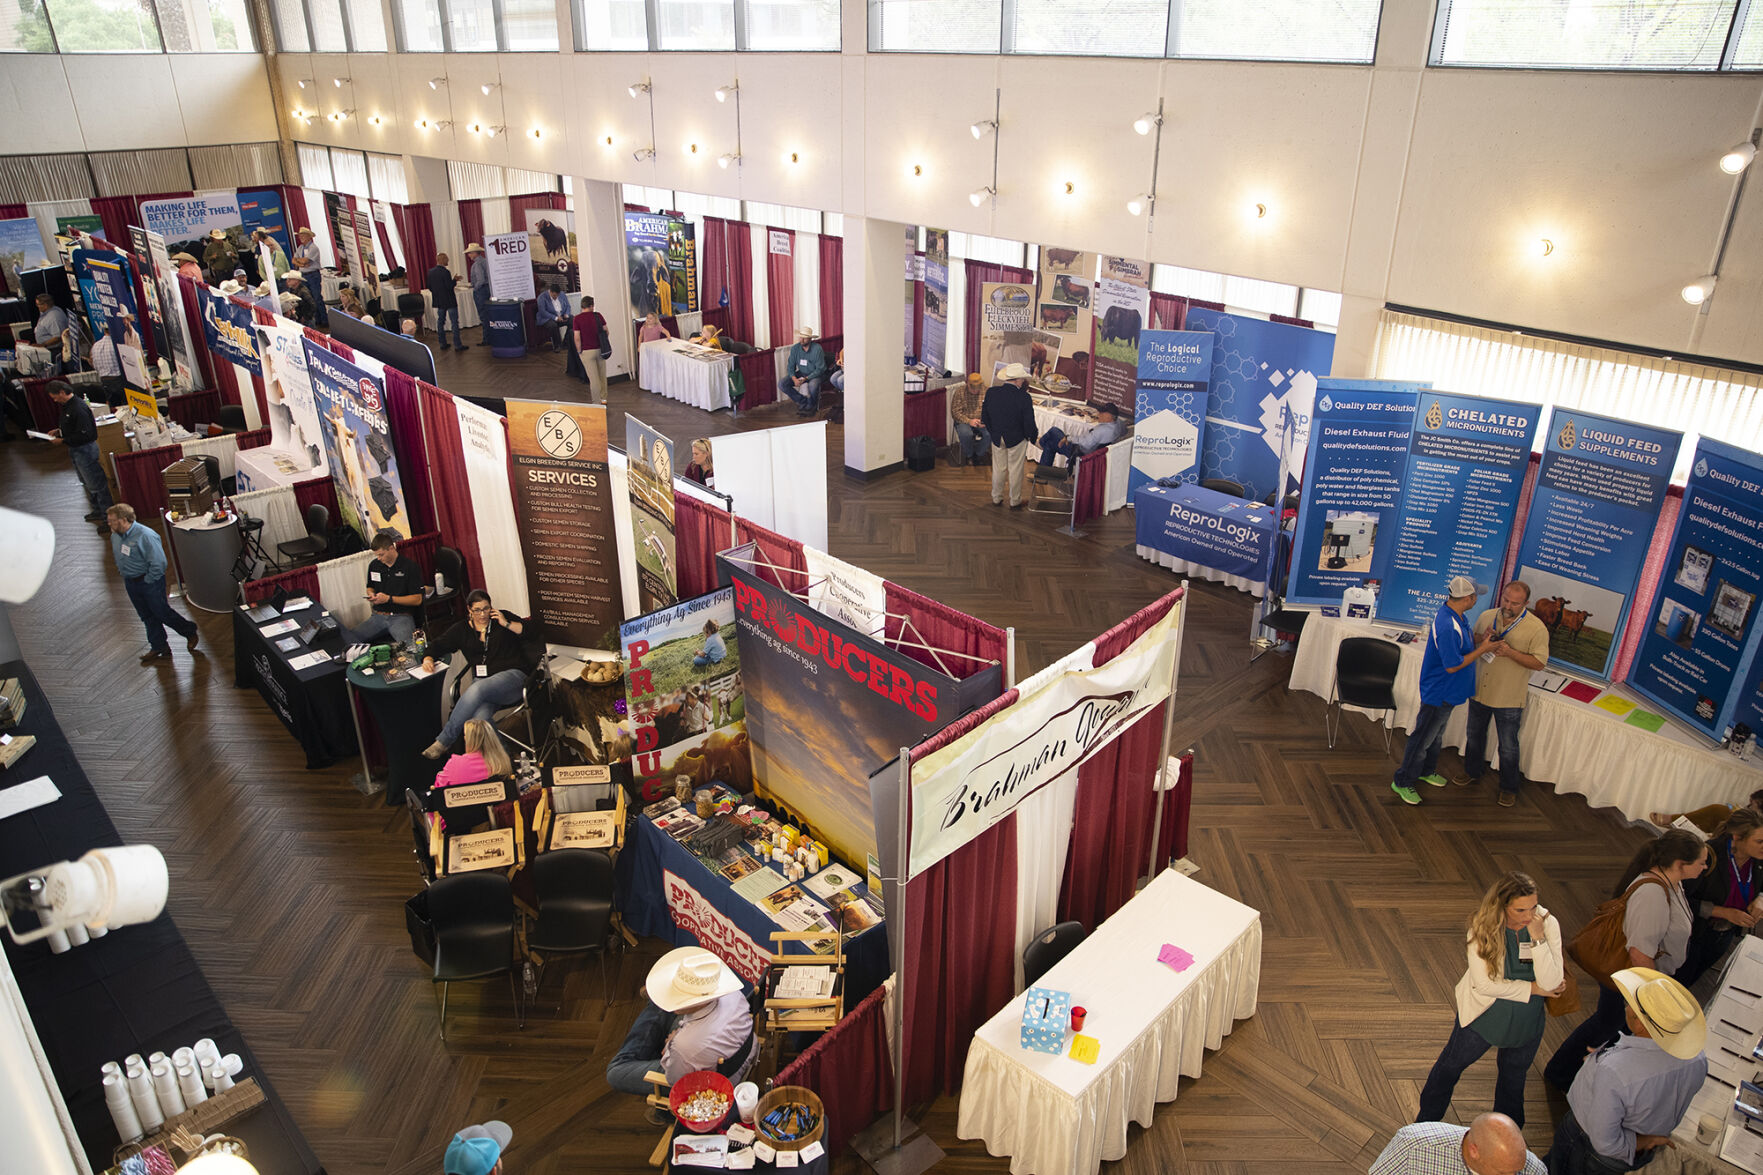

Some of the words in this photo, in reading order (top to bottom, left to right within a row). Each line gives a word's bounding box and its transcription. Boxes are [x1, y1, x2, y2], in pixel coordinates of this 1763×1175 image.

[145, 203, 185, 213] MAKING
[187, 200, 207, 210] LIFE
[148, 210, 185, 221] BETTER
[187, 209, 206, 219] FOR
[208, 206, 238, 216] THEM,
[150, 218, 184, 229] MAKES
[187, 216, 206, 226] LIFE
[501, 240, 527, 255] RED
[1150, 342, 1165, 352] The
[1167, 343, 1200, 355] Logical
[1146, 352, 1202, 364] Reproductive
[1158, 362, 1187, 373] Choice
[1142, 381, 1194, 390] www.reprologix.com
[1335, 402, 1365, 411] Quality
[1366, 403, 1384, 411] DEF
[1448, 408, 1528, 428] CHELATED
[1324, 428, 1350, 436] Diesel
[1352, 429, 1386, 438] Exhaust
[1388, 430, 1410, 439] Fluid
[1446, 421, 1525, 438] MICRONUTRIENTS
[1135, 435, 1191, 447] ReproLogix
[1323, 442, 1407, 453] qualitydefsolutions.com
[1582, 428, 1625, 445] LIQUID
[1627, 438, 1662, 454] FEED
[1579, 441, 1658, 466] SUPPLEMENTS
[537, 459, 567, 467] BREEDING
[567, 460, 591, 469] SERVICE
[1329, 467, 1350, 475] Quality
[1363, 468, 1391, 476] Solutions,
[1558, 456, 1575, 465] Liquid
[1576, 459, 1588, 467] feed
[1600, 465, 1614, 473] been
[1623, 470, 1650, 481] excellent
[528, 470, 597, 487] SERVICES
[1324, 474, 1352, 482] distributor
[1373, 477, 1399, 485] chemical,
[1549, 467, 1564, 475] many
[1564, 470, 1580, 479] years.
[1582, 473, 1597, 483] When
[1598, 478, 1611, 486] used
[1612, 481, 1636, 492] properly
[1636, 486, 1653, 496] liquid
[1554, 462, 1572, 470] choice
[1587, 470, 1605, 478] variety
[1613, 475, 1641, 487] producers
[1709, 469, 1741, 487] Quality
[1742, 480, 1760, 493] DEF
[1316, 483, 1328, 491] poly
[1357, 484, 1384, 493] fiberglass
[1546, 472, 1558, 480] feed
[1570, 478, 1583, 486] have
[1584, 482, 1599, 491] many
[1600, 485, 1622, 496] benefits
[1623, 491, 1635, 499] with
[1636, 494, 1653, 504] great
[1554, 482, 1571, 490] return
[1693, 496, 1721, 513] Diesel
[1722, 508, 1756, 528] Exhaust
[1170, 503, 1261, 543] ReproLogix
[1165, 520, 1211, 539] REPRODUCTIVE
[1211, 534, 1260, 555] TECHNOLOGIES
[1164, 529, 1190, 542] American
[1191, 538, 1214, 550] Owned
[1214, 544, 1227, 553] and
[1227, 549, 1259, 564] Operated
[623, 612, 671, 637] Everything
[673, 606, 686, 622] Ag
[687, 597, 712, 615] Since
[731, 575, 938, 722] PRODUCERS
[774, 641, 783, 654] ag
[783, 643, 800, 661] since
[801, 657, 818, 675] 1943
[558, 769, 604, 778] PRODUCERS
[451, 787, 498, 799] PRODUCERS
[940, 739, 1067, 832] Brahman
